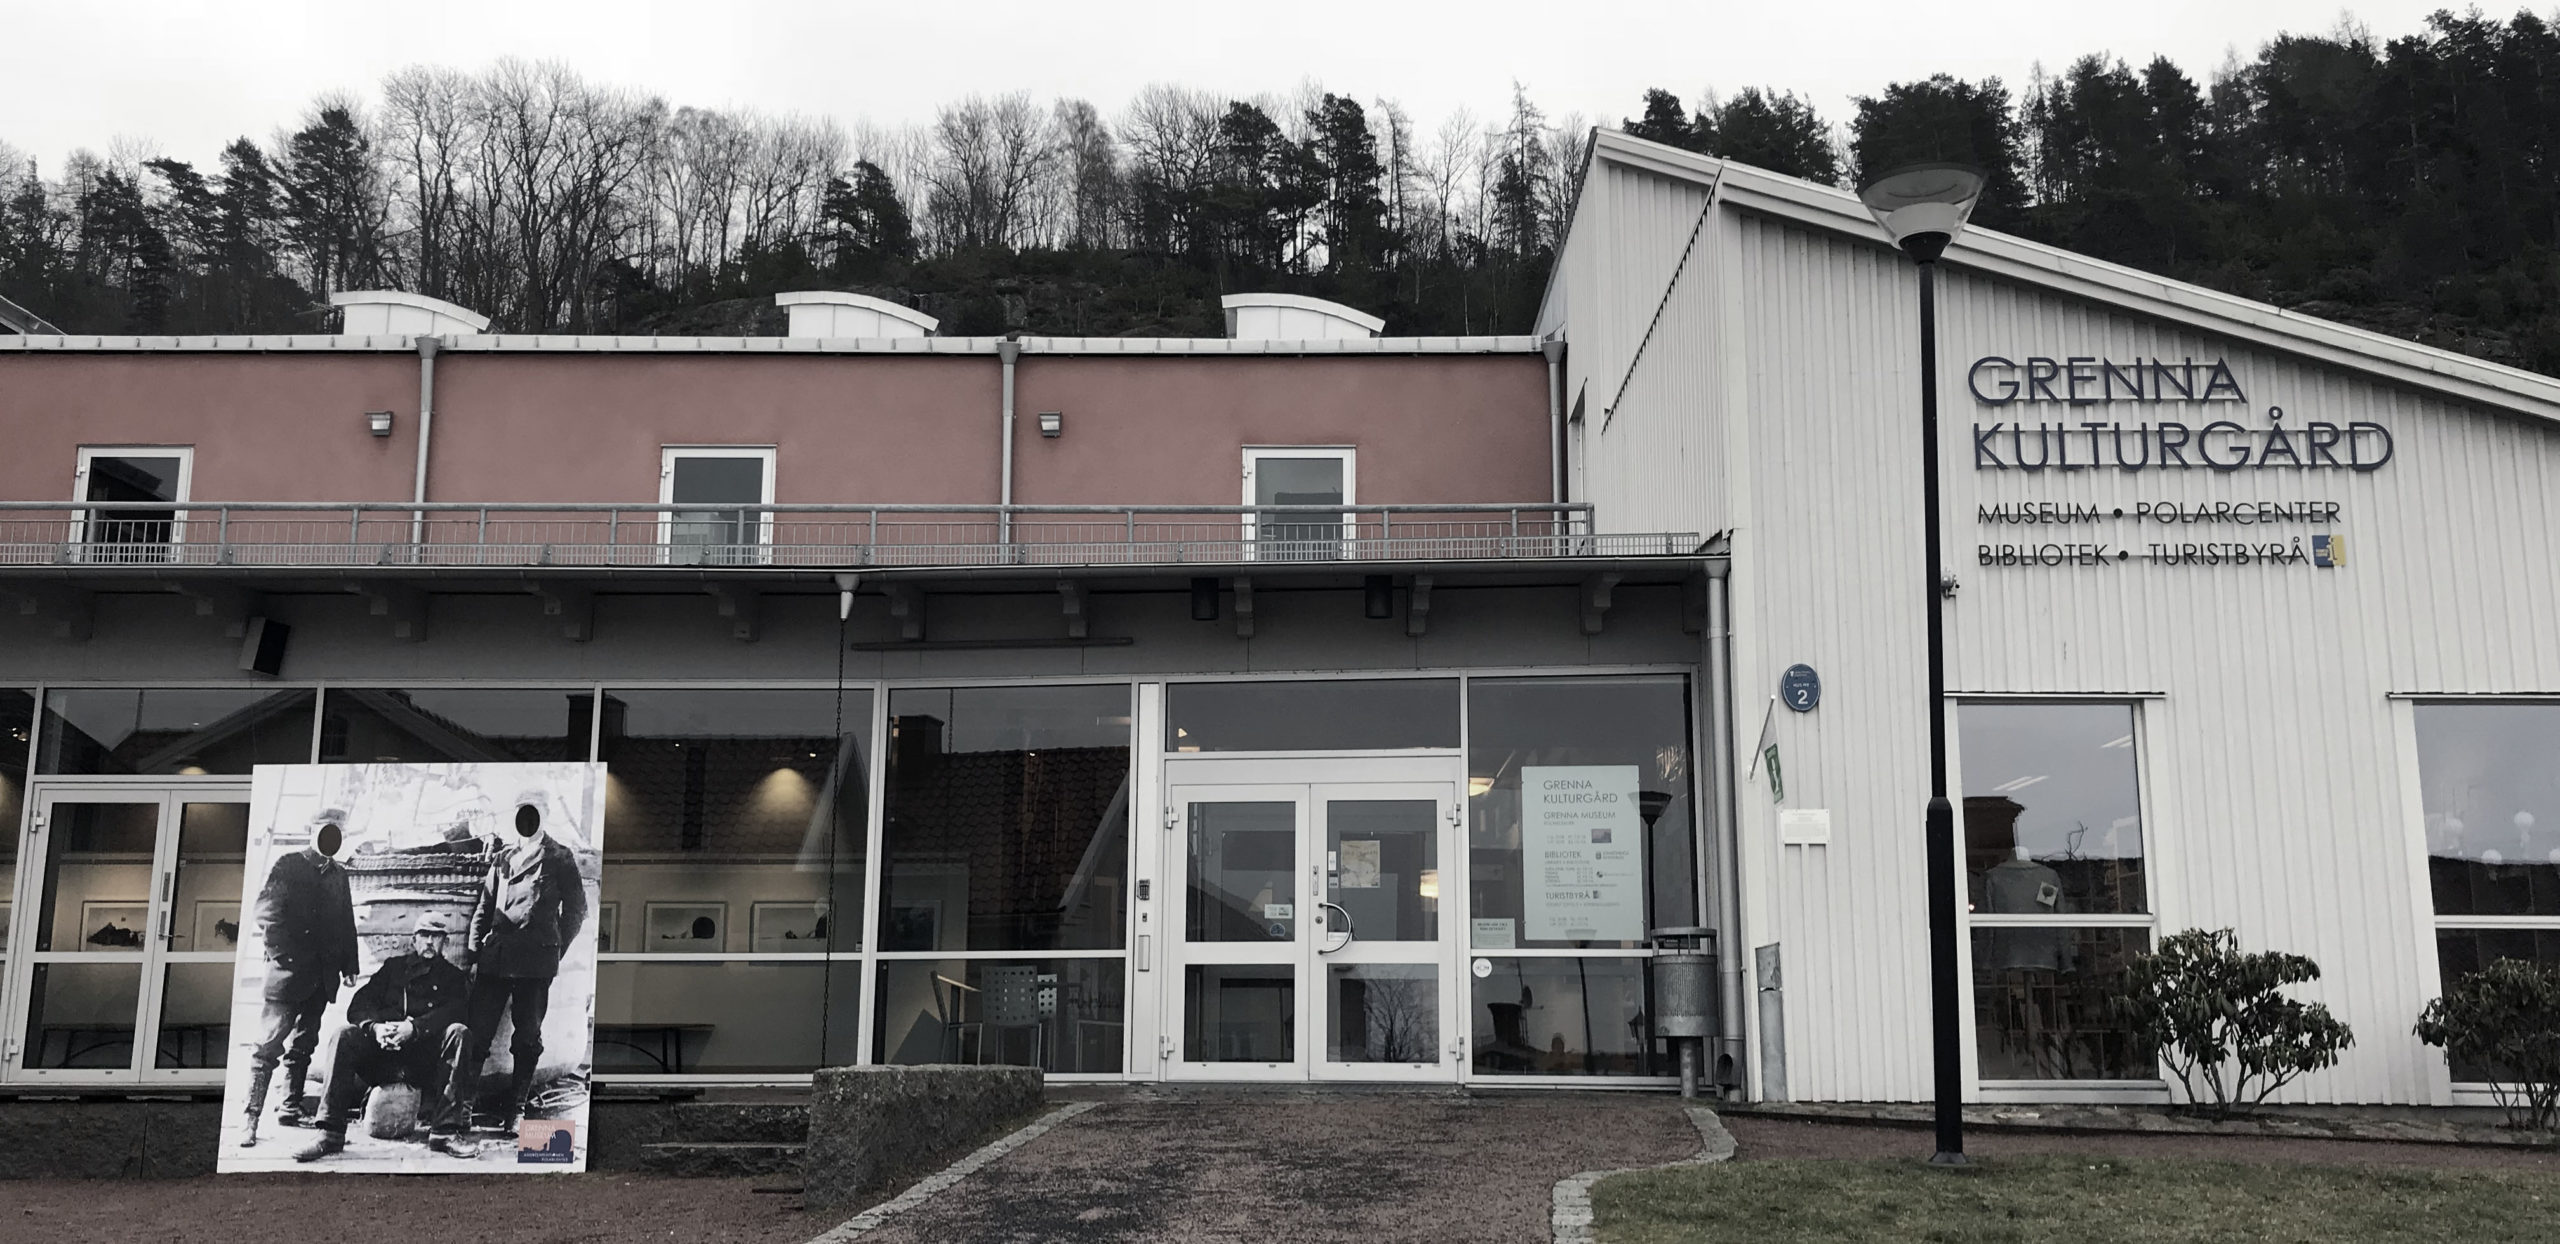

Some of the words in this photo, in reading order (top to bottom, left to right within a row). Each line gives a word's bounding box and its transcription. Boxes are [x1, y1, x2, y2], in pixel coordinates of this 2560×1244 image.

[1968, 356, 2248, 407] GRENNA
[1973, 406, 2394, 472] KULTURGÅRD
[1977, 502, 2102, 525] MUSEUM
[2136, 500, 2342, 526] POLARCENTER
[1978, 543, 2110, 567] BIBLIOTEK
[2147, 536, 2311, 567] TURISTBYRÅ
[1797, 690, 1808, 705] 2
[1543, 780, 1593, 791] GRENNA
[1543, 791, 1618, 804] KULTURGÅRD
[1543, 811, 1579, 820] GRENNA
[1581, 811, 1616, 820] MUSEUM
[1544, 851, 1582, 859] BIBLIOTEK
[1545, 890, 1591, 900] TURISTBYRÅ
